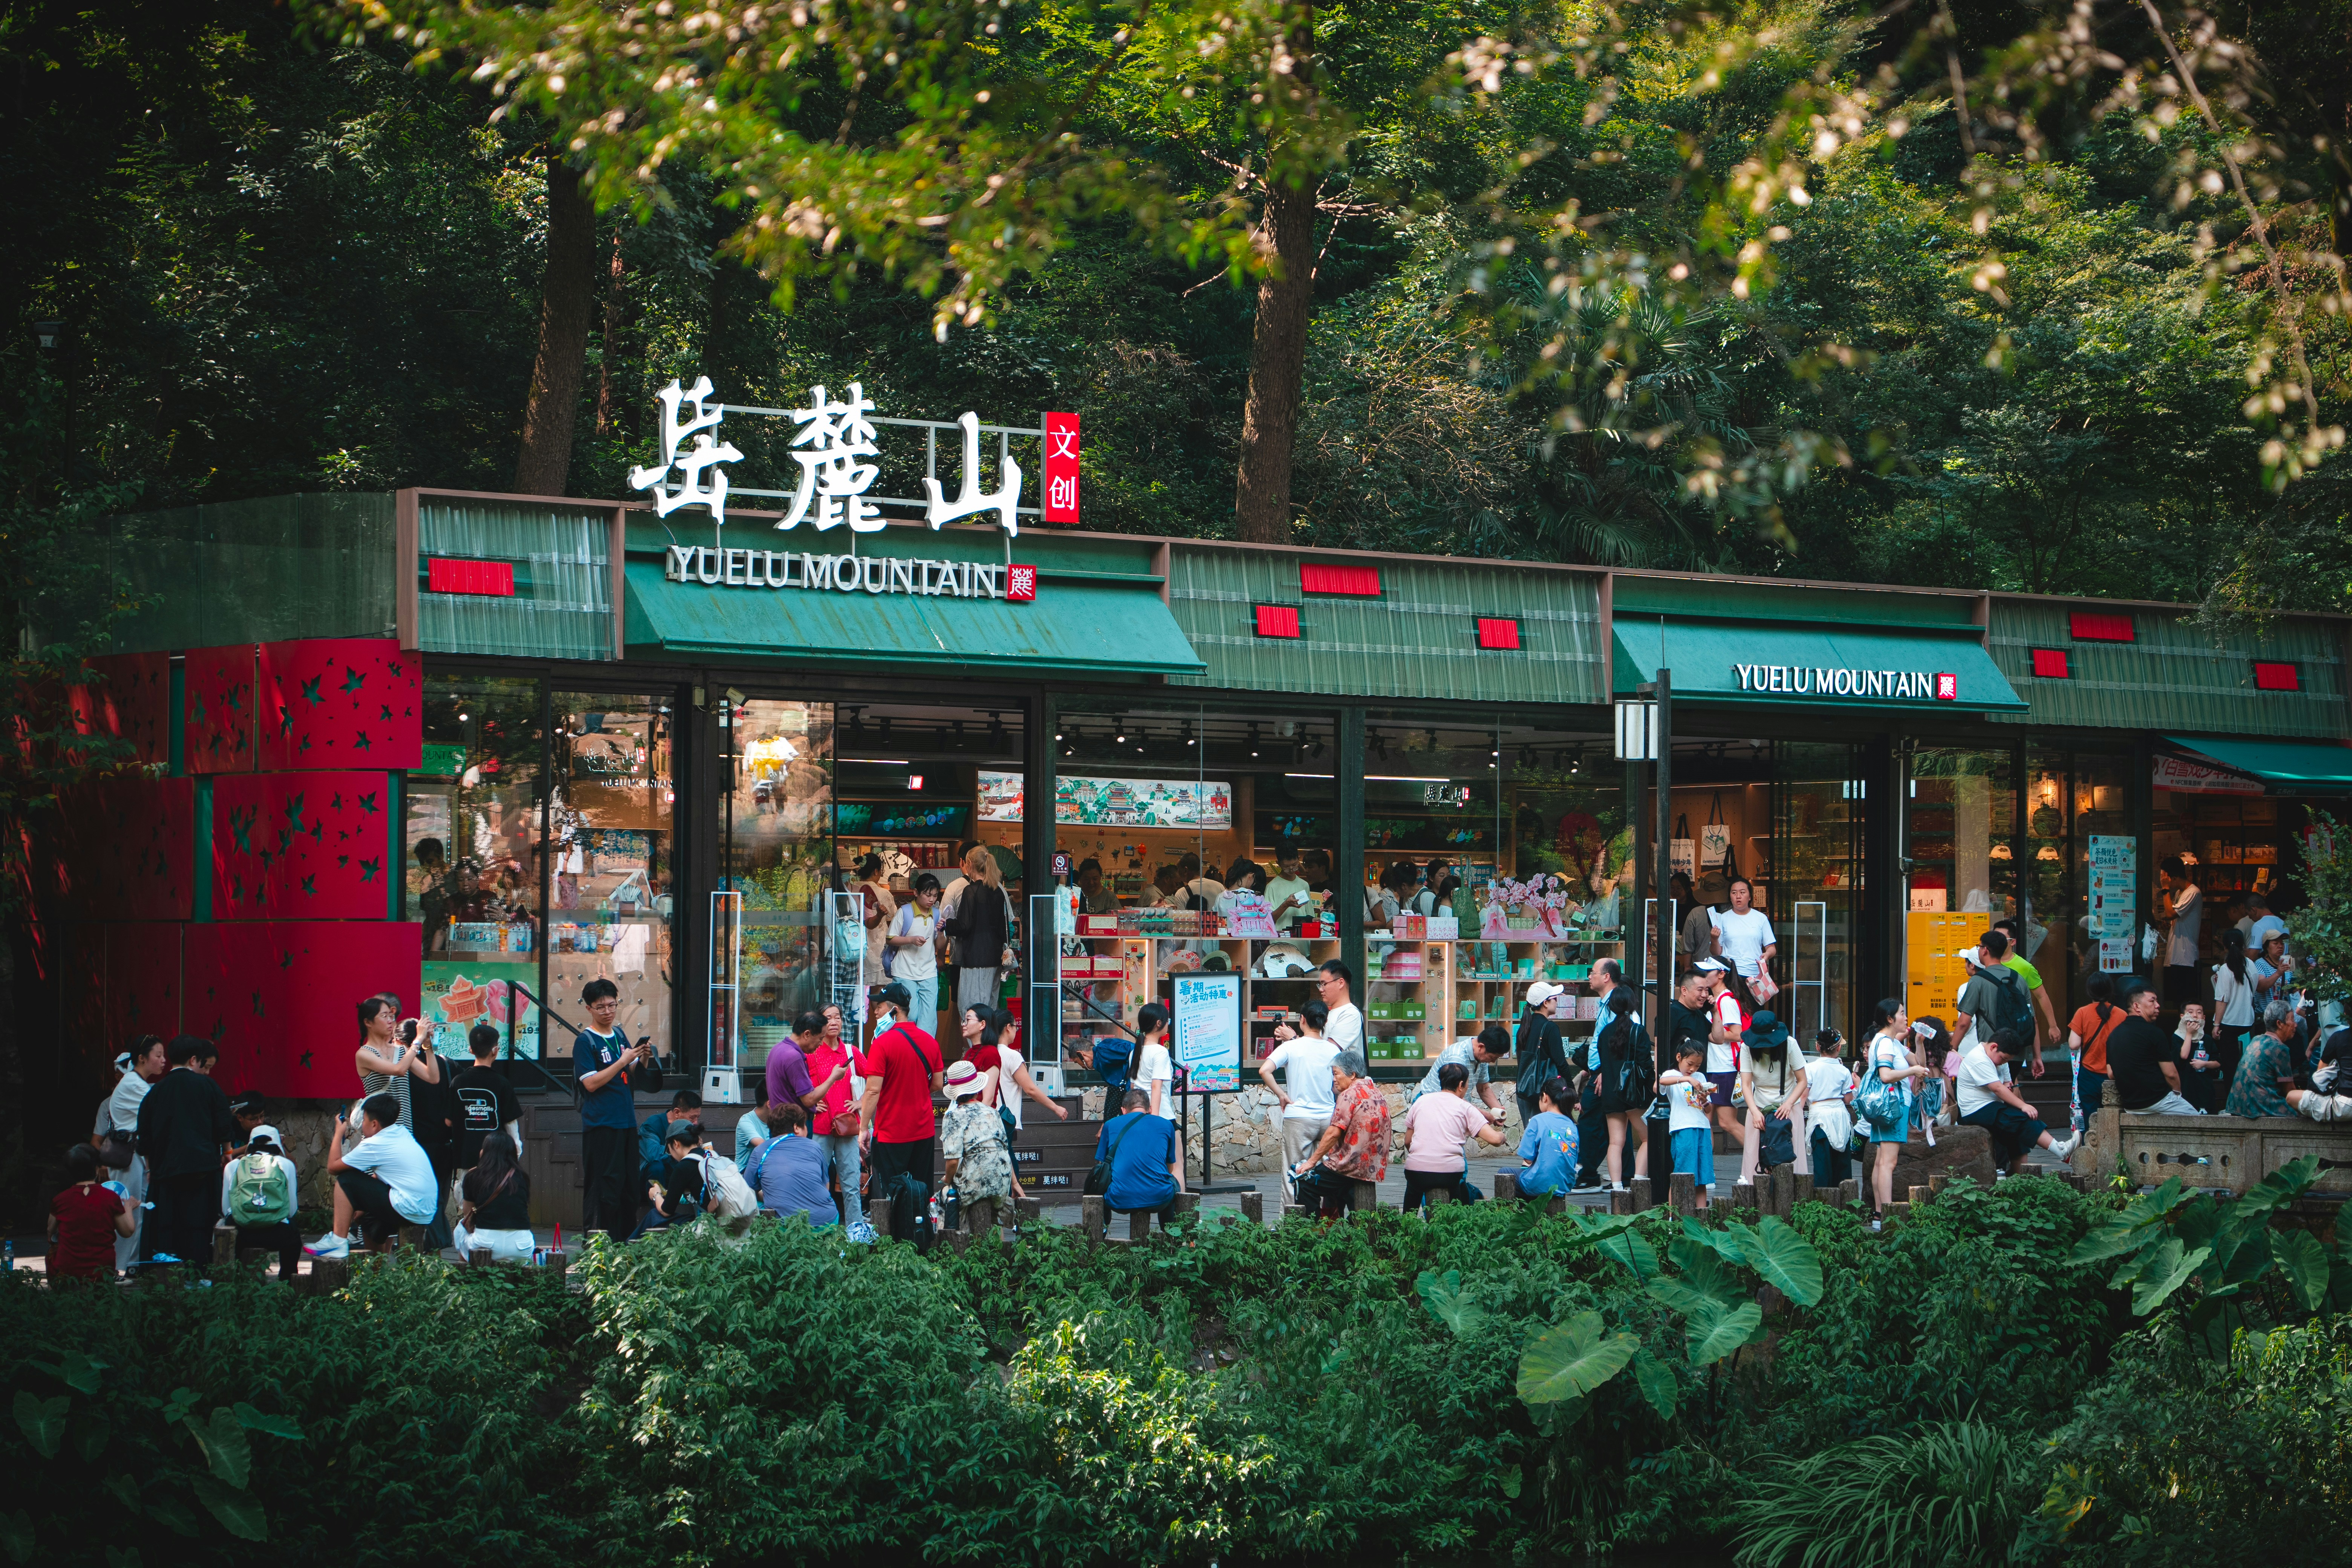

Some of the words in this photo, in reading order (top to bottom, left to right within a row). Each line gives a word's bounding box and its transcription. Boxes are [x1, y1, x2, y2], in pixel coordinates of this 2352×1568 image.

[627, 375, 1022, 537] 岳麓山
[1049, 424, 1076, 510] 文创
[668, 545, 789, 588] YUELU
[801, 553, 996, 599] MOUNTAIN
[1736, 664, 1809, 693] YUELU
[1816, 668, 1932, 698] MOUNTAIN
[1911, 899, 1930, 907] 岳麓山
[1190, 989, 1227, 1004] 活动特惠
[601, 1051, 612, 1063] 10
[1043, 1175, 1069, 1185] 莫绊哒!
